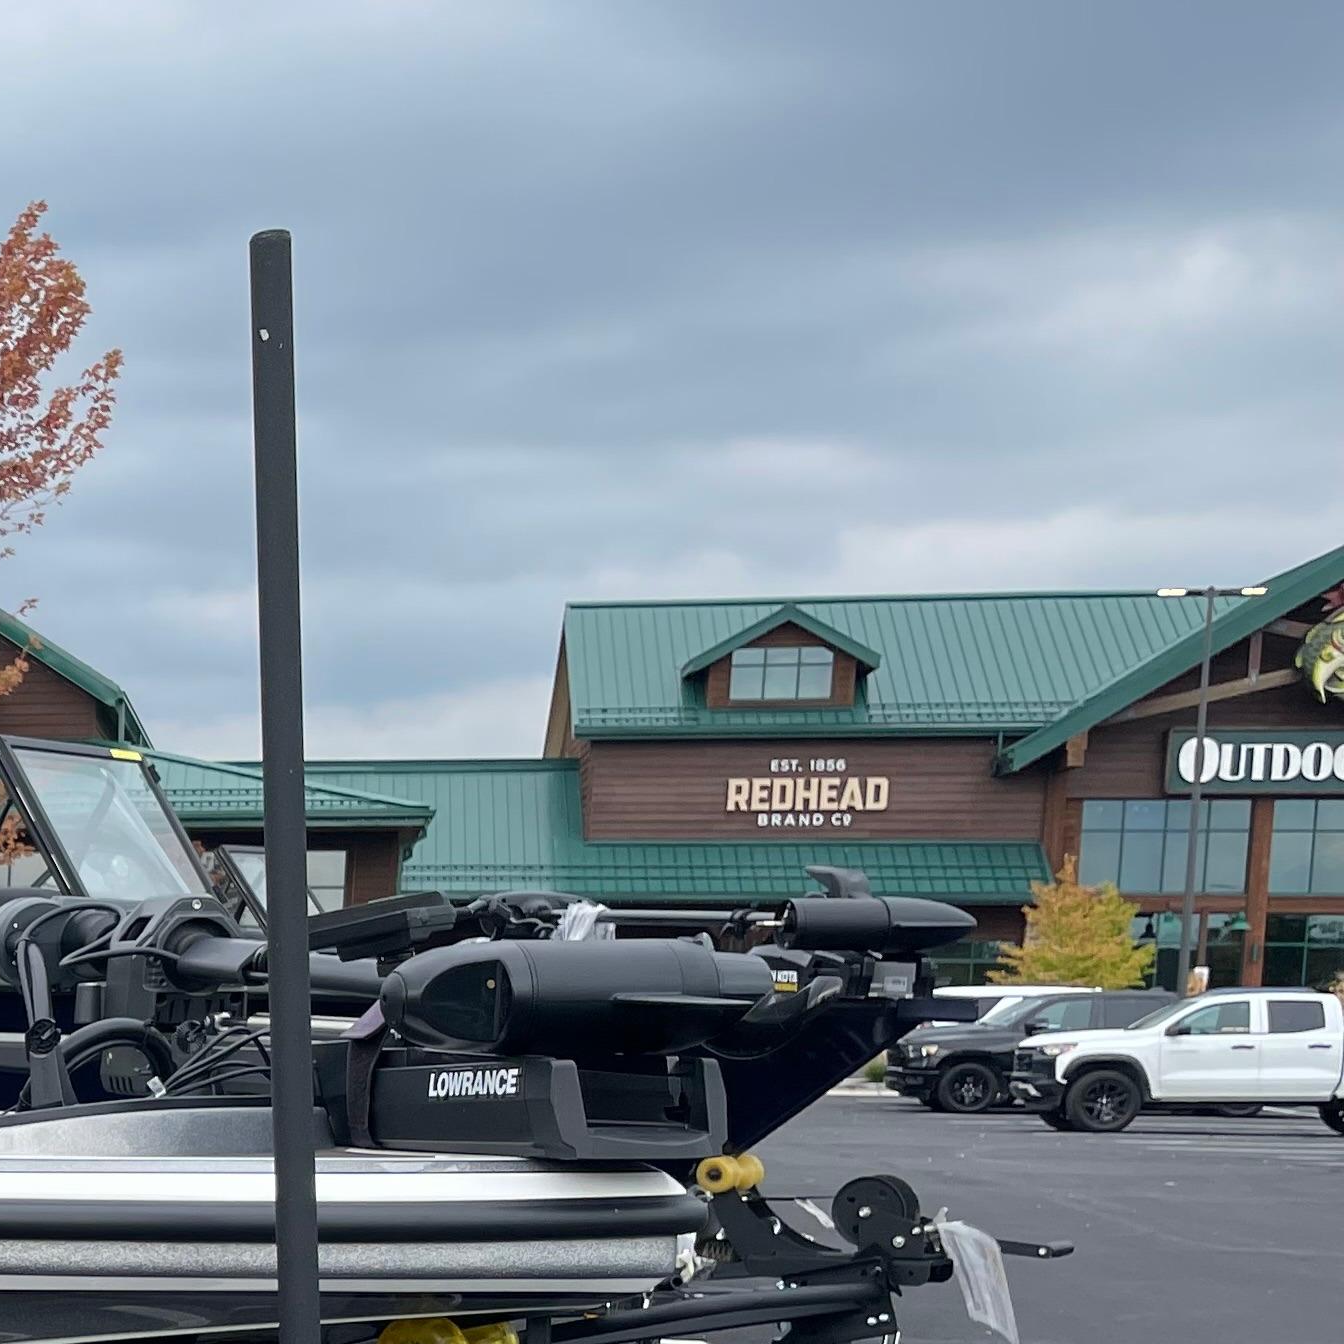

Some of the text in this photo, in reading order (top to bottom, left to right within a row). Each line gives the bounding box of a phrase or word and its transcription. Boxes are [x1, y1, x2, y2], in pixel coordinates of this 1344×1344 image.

[770, 758, 847, 772] EST. 1856
[726, 776, 891, 812] REDHEAD
[757, 812, 825, 827] BRAND
[428, 1068, 520, 1098] LOWRANCE
